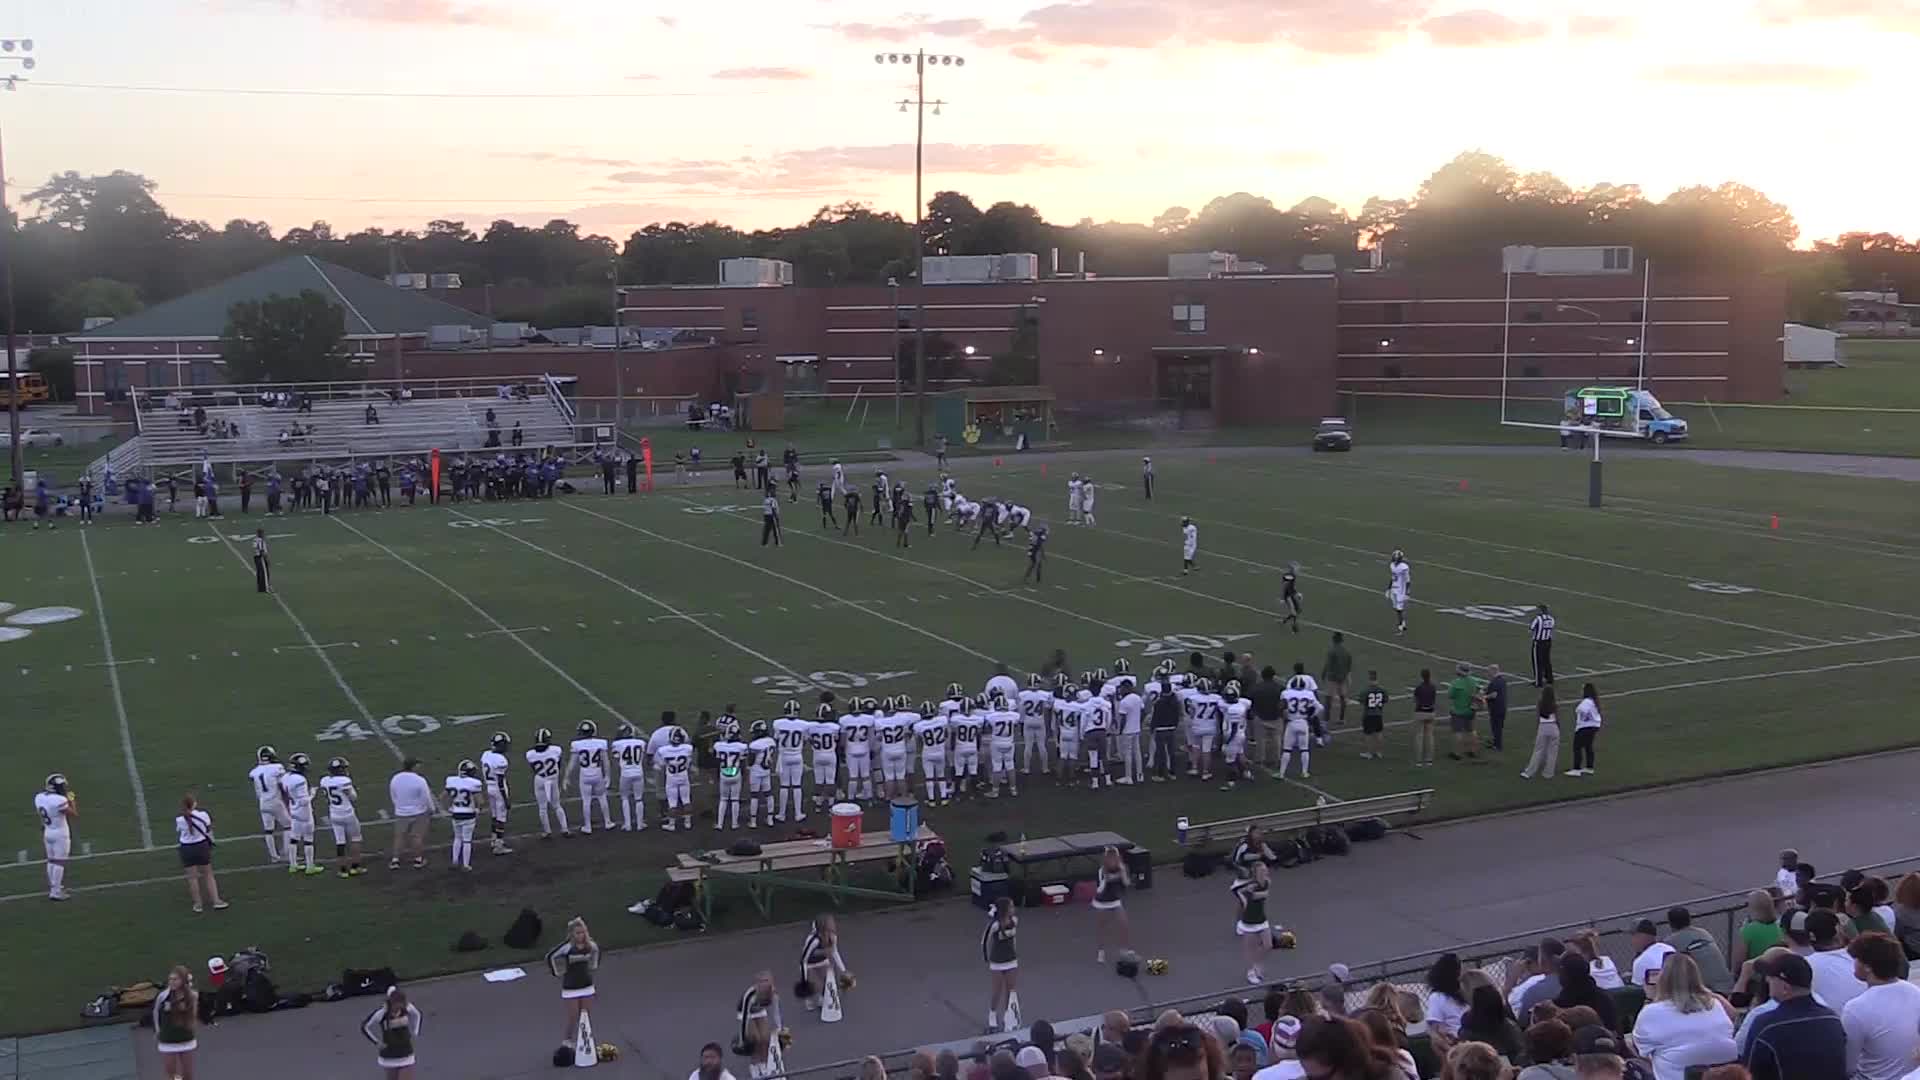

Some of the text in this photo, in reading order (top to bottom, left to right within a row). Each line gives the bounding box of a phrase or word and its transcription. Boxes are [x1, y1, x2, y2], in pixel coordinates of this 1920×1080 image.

[751, 671, 869, 694] 30
[1023, 701, 1043, 717] 24
[1288, 697, 1309, 714] 33
[1368, 693, 1383, 707] 22
[1093, 708, 1104, 726] 3
[1196, 702, 1218, 719] 77
[315, 714, 442, 741] 40
[846, 726, 869, 742] 73
[883, 726, 904, 744] 62
[923, 727, 945, 746] 82
[958, 725, 977, 742] 80
[995, 721, 1012, 737] 71
[779, 730, 802, 747] 70
[579, 749, 601, 768] 34
[622, 745, 643, 765] 40
[484, 763, 496, 780] 2
[532, 758, 557, 777] 22
[664, 755, 688, 774] 52
[259, 773, 268, 792] 1
[448, 787, 471, 807] 23
